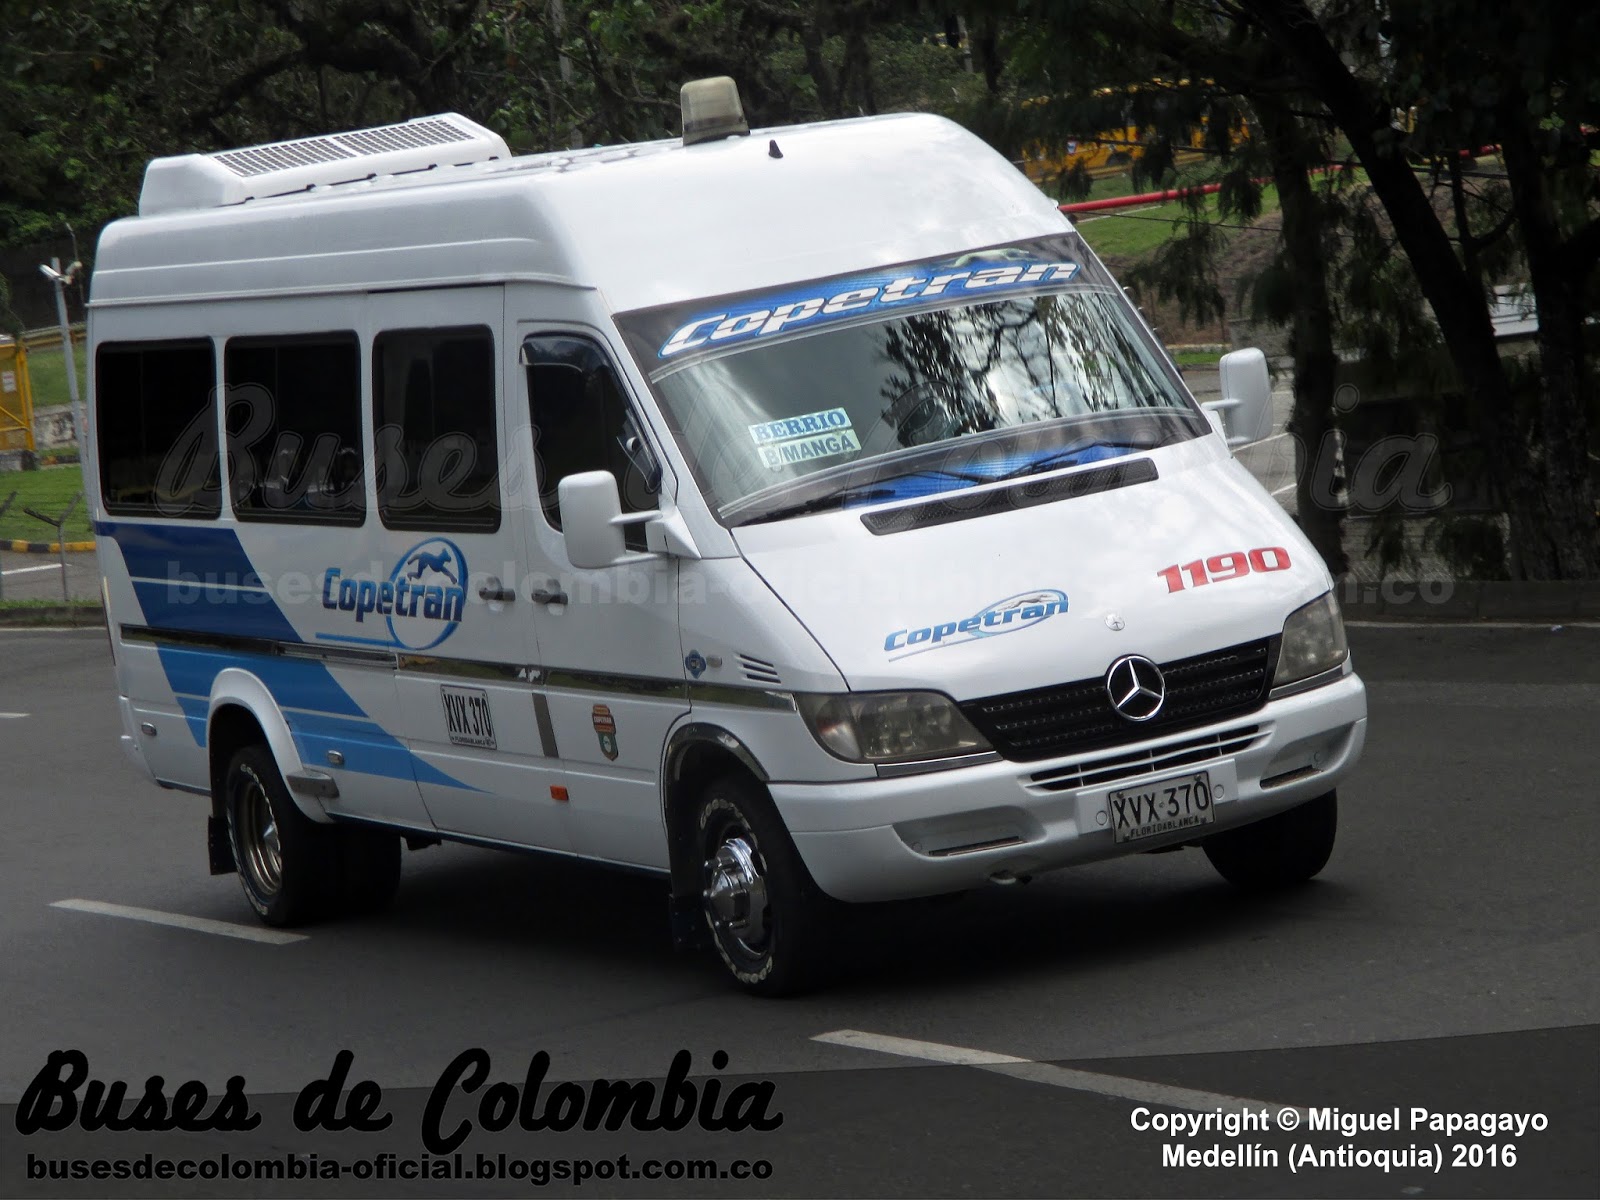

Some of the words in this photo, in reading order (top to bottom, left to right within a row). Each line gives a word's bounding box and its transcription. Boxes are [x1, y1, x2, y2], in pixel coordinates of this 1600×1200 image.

[658, 261, 1081, 358] Copetran
[753, 411, 846, 441] BERRIO
[763, 434, 856, 465] B/MANGA
[322, 566, 464, 622] Copetran
[1157, 546, 1293, 594] 1190
[883, 600, 1069, 653] Copetran
[443, 693, 472, 734] XVX
[468, 695, 493, 738] 370
[1113, 792, 1161, 829] XVX
[1163, 780, 1210, 817] 370
[1130, 815, 1199, 838] FLORIDABLANCA
